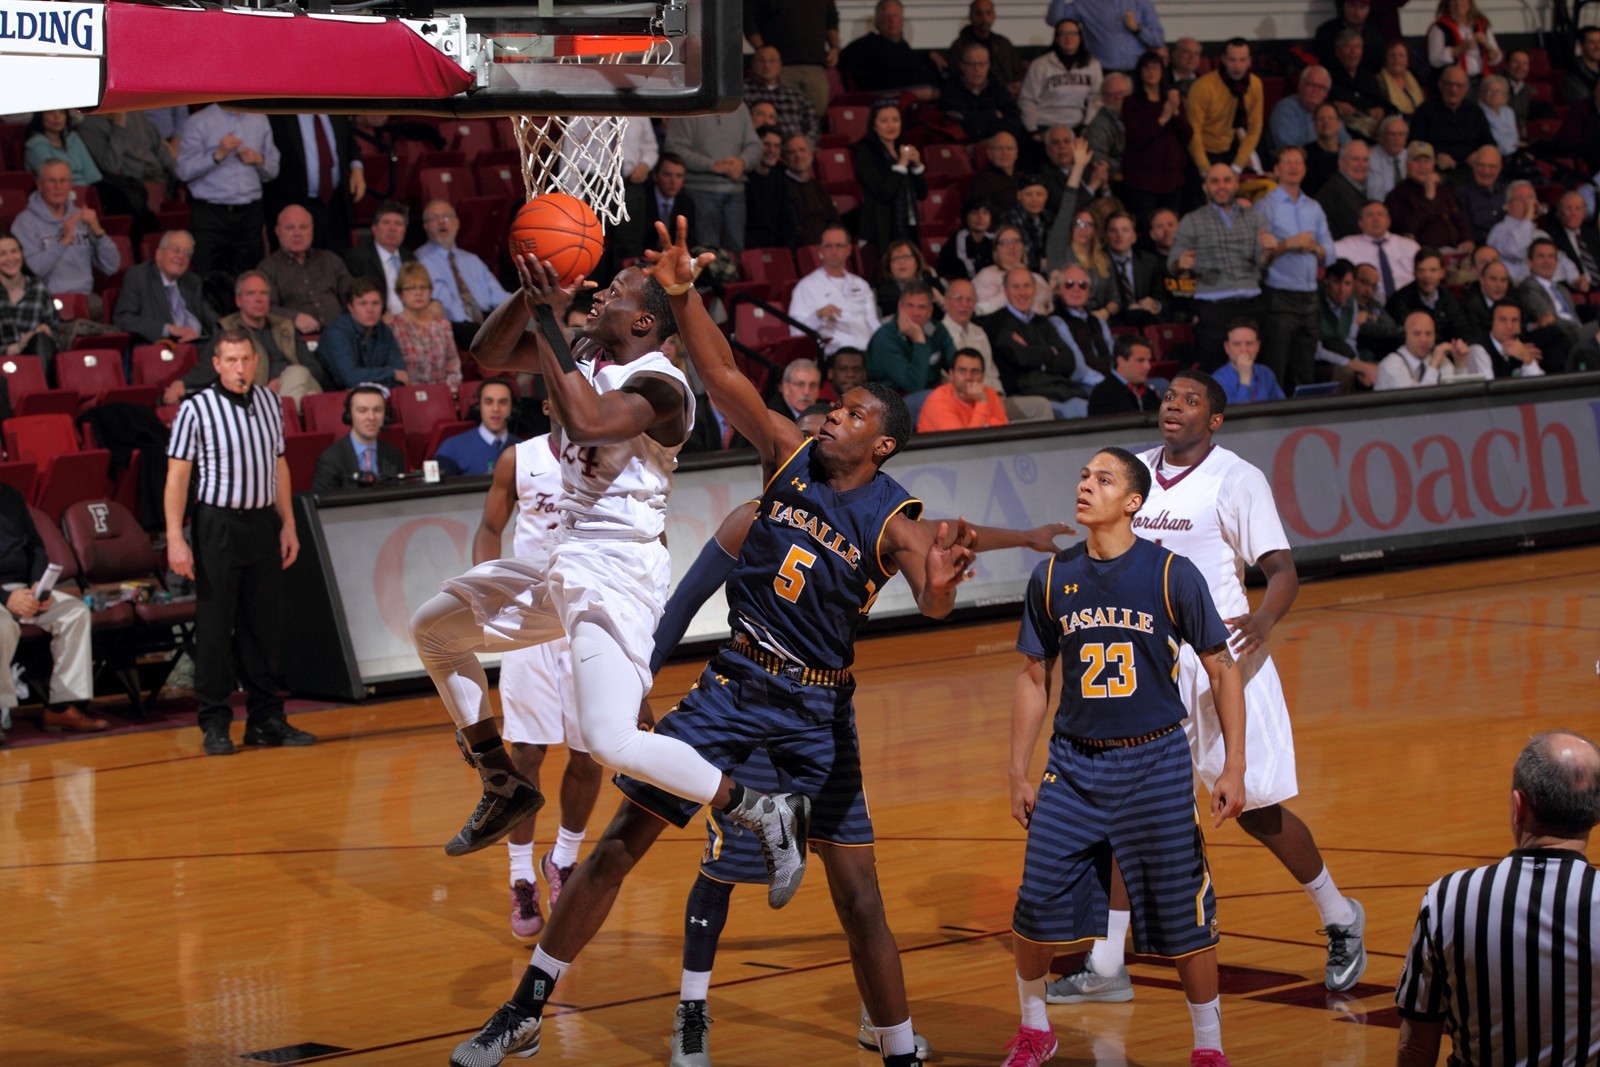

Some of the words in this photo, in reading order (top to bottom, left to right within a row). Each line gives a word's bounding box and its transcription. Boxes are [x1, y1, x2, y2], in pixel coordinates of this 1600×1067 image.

[0, 8, 93, 51] LDING
[1272, 404, 1590, 540] Coach
[535, 492, 561, 515] Fo
[1131, 509, 1194, 531] ordham
[768, 500, 862, 570] LASALLE
[773, 543, 817, 604] 5
[1059, 606, 1154, 636] LASALLE
[1080, 641, 1137, 698] 23
